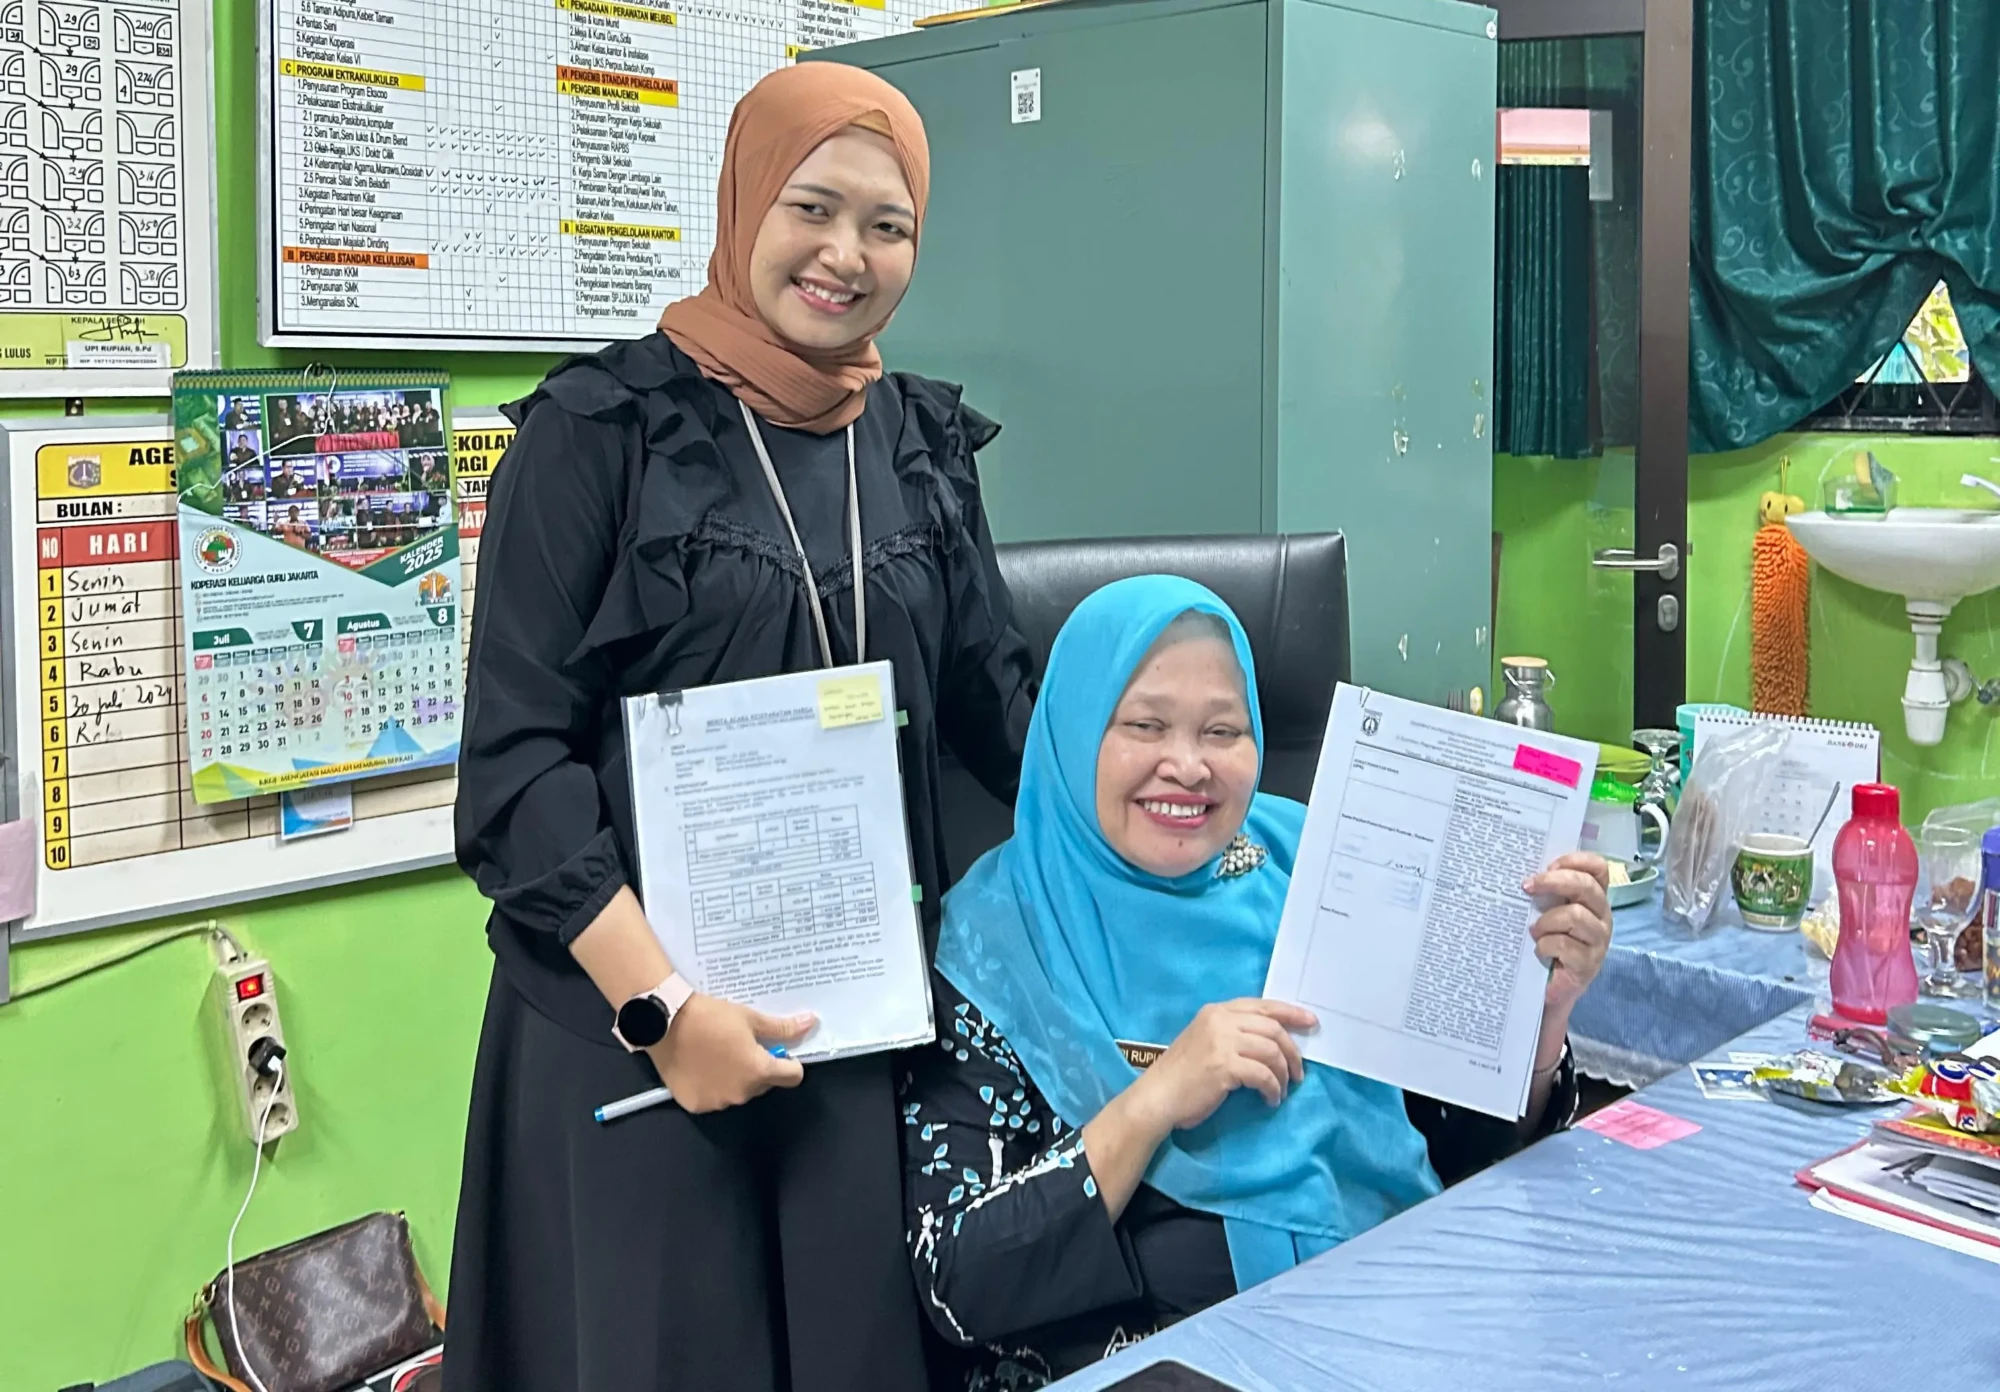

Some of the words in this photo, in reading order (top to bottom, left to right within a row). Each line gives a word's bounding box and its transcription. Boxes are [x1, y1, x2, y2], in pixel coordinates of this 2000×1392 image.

[571, 1, 608, 15] PENGADAAN
[614, 6, 648, 21] PERAWATAN
[650, 12, 673, 25] MEUBEL
[329, 35, 355, 51] Koperasi
[285, 63, 291, 74] C
[297, 66, 334, 80] PROGRAM
[571, 70, 600, 84] PENGEMB
[602, 74, 629, 87] STANDAR
[631, 77, 673, 93] PENGELOLAAN
[120, 85, 127, 97] 4
[562, 82, 566, 92] A
[571, 84, 600, 97] PENGEMB
[602, 88, 638, 101] MANAJEMEN
[352, 222, 376, 234] Nasional
[576, 224, 605, 236] KEGIATAN
[607, 226, 650, 239] PENGELOLAAN
[652, 228, 675, 240] KANTOR
[300, 251, 336, 264] PENGEMB
[338, 253, 371, 266] STANDAR
[373, 254, 416, 267] KELULUSAN
[71, 317, 103, 325] KEPALA
[5, 348, 31, 358] LULUS
[129, 447, 174, 466] AGE
[464, 480, 490, 493] TAH
[42, 537, 58, 559] NO
[90, 532, 148, 556] HARI
[400, 535, 444, 565] KALENDER
[405, 546, 443, 576] 2025
[48, 575, 55, 592] 1
[68, 568, 124, 592] Senin
[191, 579, 227, 591] KOPERASI
[229, 576, 265, 588] KELUARGA
[267, 574, 286, 584] GURU
[288, 570, 319, 583] JAKARTA
[48, 605, 56, 622] 2
[438, 607, 448, 625] 8
[304, 621, 315, 640] 7
[347, 619, 380, 635] Agustus
[48, 635, 56, 653] 3
[71, 626, 123, 653] Senin
[213, 633, 230, 646] Juli
[49, 665, 57, 682] 4
[81, 657, 143, 682] Rabu
[240, 671, 244, 680] 1
[258, 669, 263, 678] 2
[276, 667, 281, 675] 3
[294, 664, 300, 673] 4
[312, 662, 317, 671] 5
[202, 693, 207, 703] 6
[221, 691, 226, 700] 7
[240, 689, 245, 698] 8
[258, 687, 264, 696] 9
[275, 684, 284, 693] 10
[294, 682, 301, 691] 11
[312, 680, 320, 689] 12
[50, 696, 58, 713] 5
[201, 712, 210, 721] 13
[220, 710, 229, 719] 14
[239, 707, 248, 717] 15
[257, 704, 266, 714] 16
[276, 702, 285, 711] 17
[294, 699, 302, 709] 18
[312, 697, 320, 706] 19
[51, 725, 59, 743] 6
[201, 730, 212, 740] 20
[221, 727, 230, 738] 21
[239, 724, 249, 734] 22
[258, 722, 268, 732] 23
[275, 719, 287, 729] 24
[294, 717, 304, 726] 25
[312, 714, 322, 724] 26
[202, 748, 212, 758] 27
[221, 745, 232, 755] 28
[240, 743, 251, 753] 29
[258, 740, 269, 750] 30
[278, 737, 287, 747] 31
[52, 756, 60, 773] 7
[53, 785, 61, 803] 8
[54, 815, 62, 833] 9
[51, 846, 66, 863] 10
[1131, 1050, 1159, 1064] RUPI
